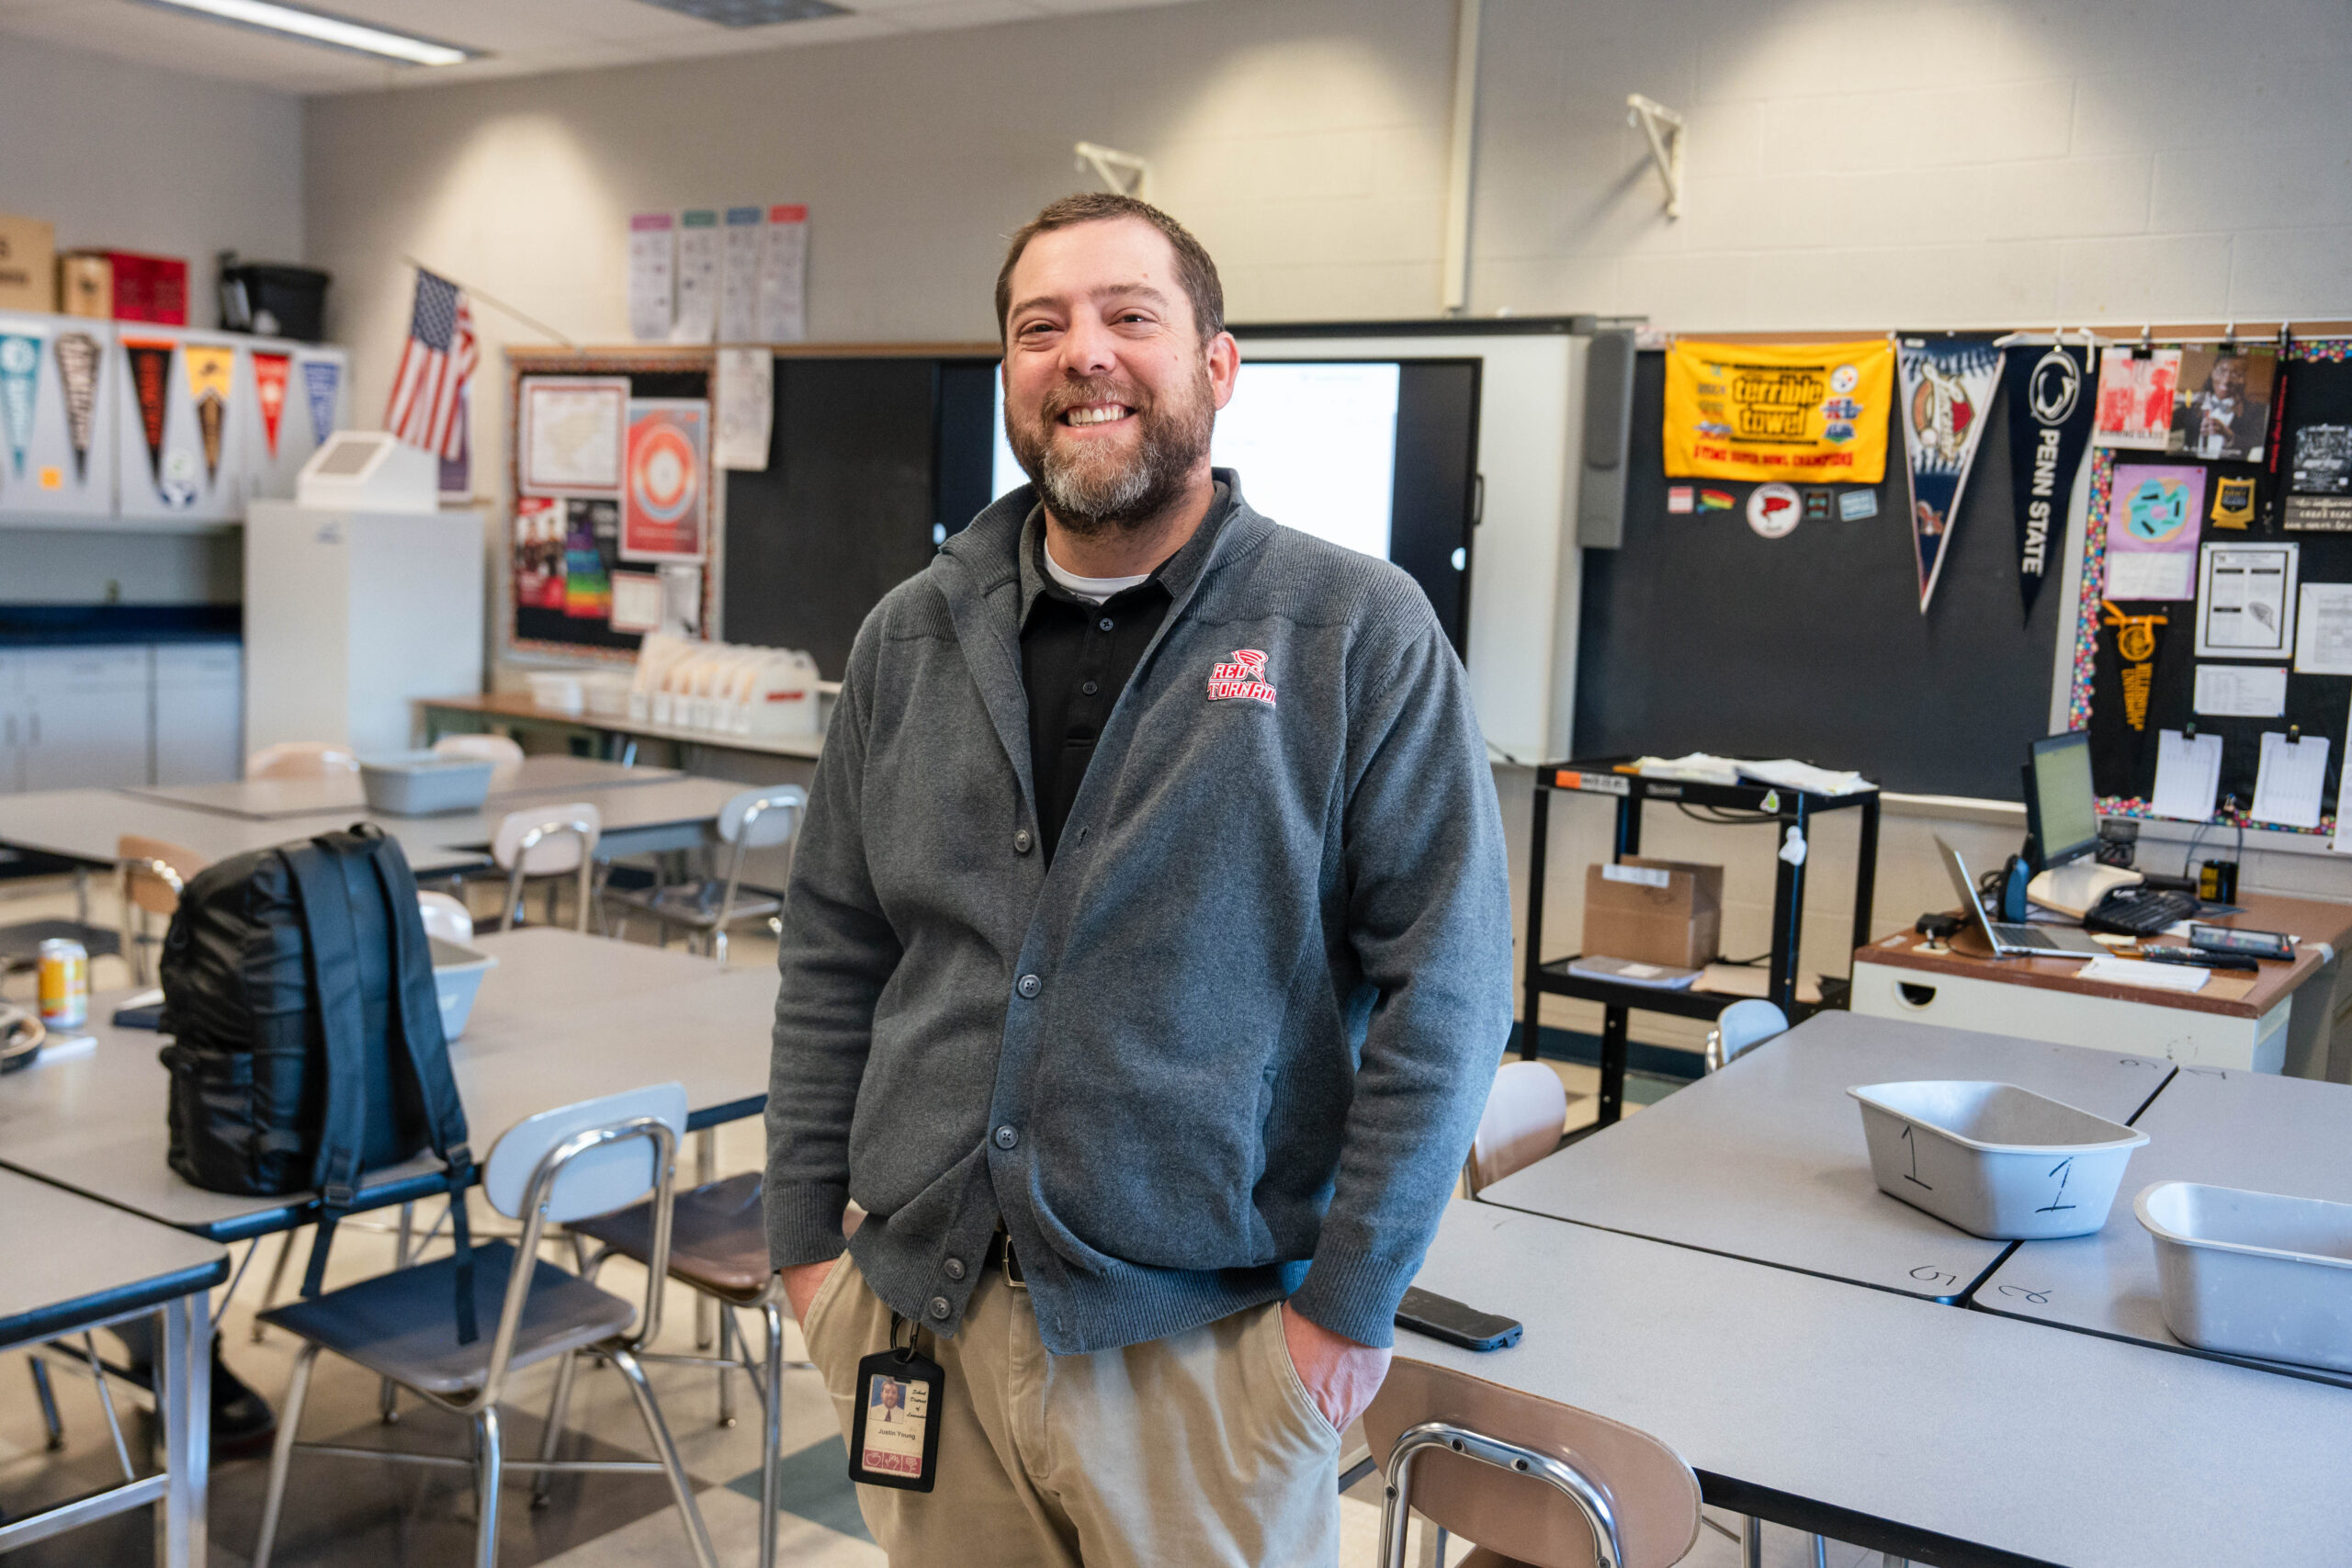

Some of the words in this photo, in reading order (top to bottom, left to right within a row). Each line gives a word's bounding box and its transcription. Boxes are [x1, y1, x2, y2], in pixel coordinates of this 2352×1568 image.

[1733, 374, 1824, 405] terrible
[1740, 406, 1807, 436] towel
[2031, 428, 2061, 497] PENN
[2021, 501, 2052, 577] STATE
[1213, 663, 1249, 680] RED
[1207, 682, 1276, 705] TORNAD
[1901, 1124, 1933, 1191] 1
[2035, 1156, 2076, 1213] 1
[897, 1430, 916, 1440] Young
